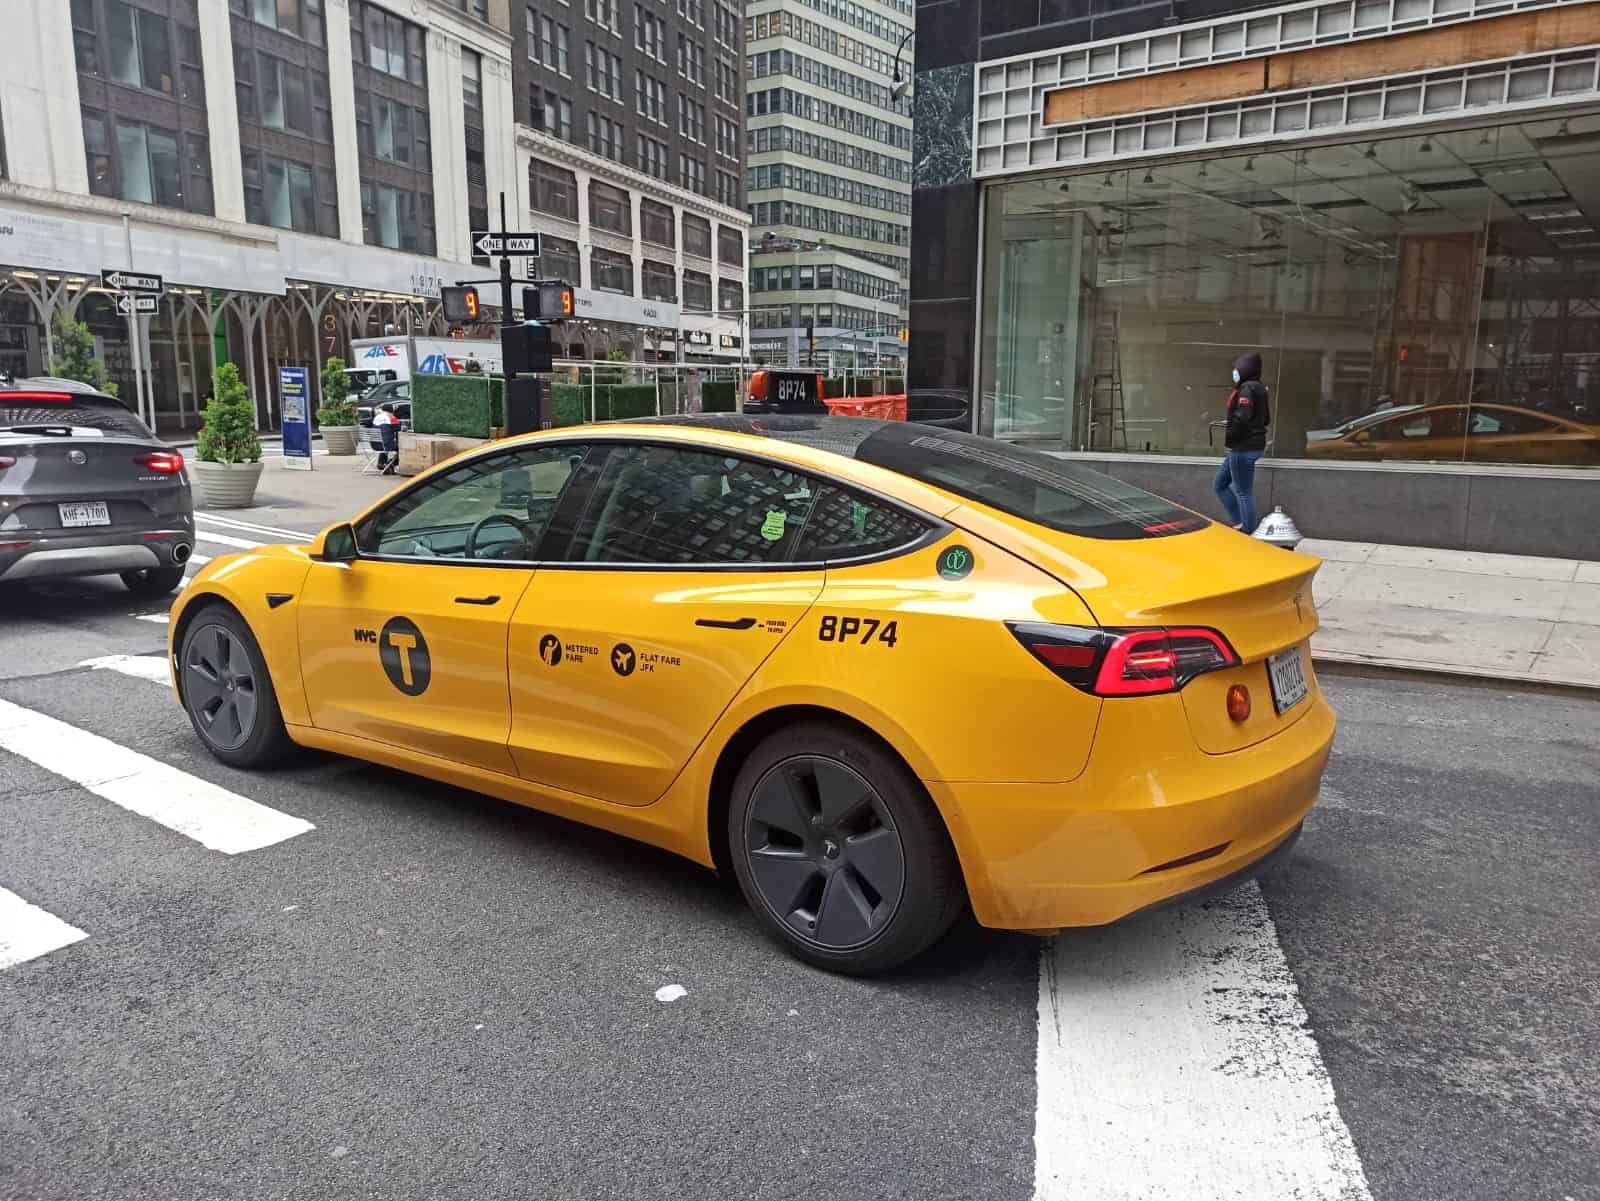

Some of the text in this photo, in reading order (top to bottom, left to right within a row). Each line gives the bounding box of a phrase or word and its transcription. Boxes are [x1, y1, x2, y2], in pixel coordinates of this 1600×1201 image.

[482, 239, 530, 249] ONE WAY
[111, 275, 156, 289] ONE WAY
[464, 292, 478, 316] 9
[562, 291, 572, 314] 9
[778, 380, 806, 401] 8P74
[353, 629, 377, 643] NYC
[818, 615, 898, 648] 8P74
[565, 643, 599, 655] METERED
[565, 653, 584, 663] FARE
[640, 652, 681, 666] FLAT FARE
[640, 663, 655, 673] JFK
